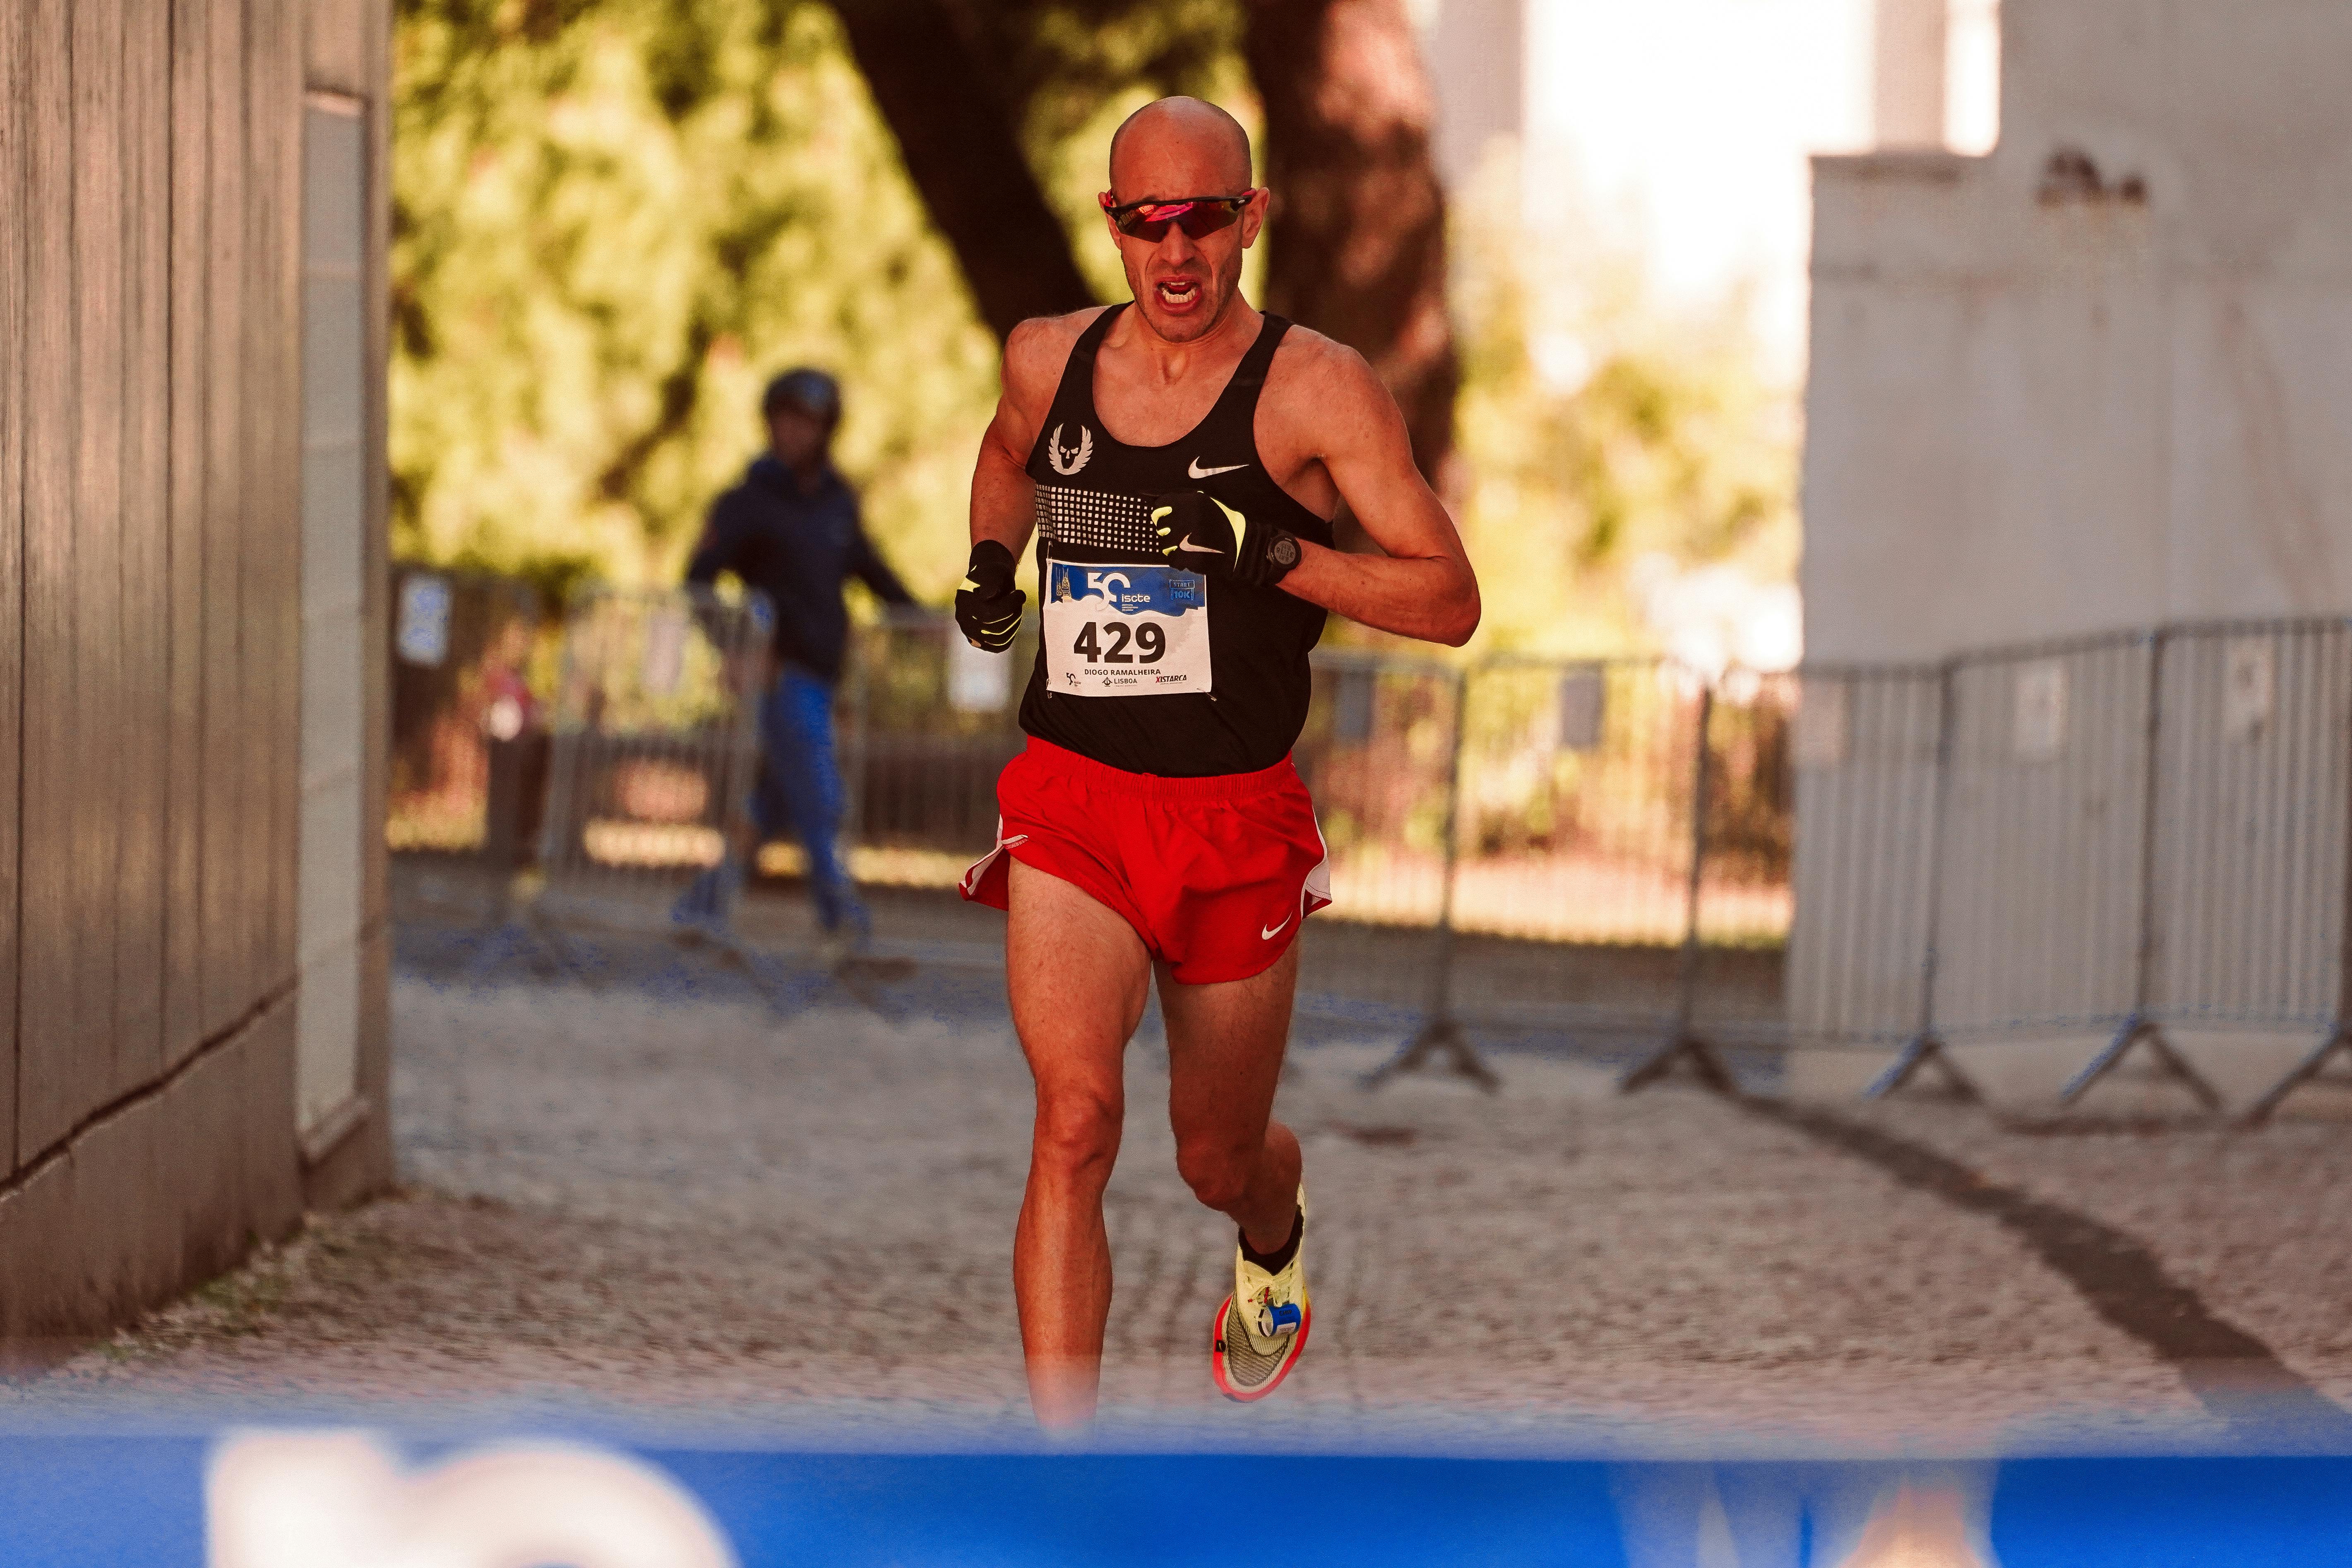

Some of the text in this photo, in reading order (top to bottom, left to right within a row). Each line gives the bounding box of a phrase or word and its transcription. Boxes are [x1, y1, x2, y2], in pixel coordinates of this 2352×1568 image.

[1122, 593, 1151, 603] iscte
[1074, 622, 1165, 664] 429
[1156, 675, 1187, 683] XISTARCA
